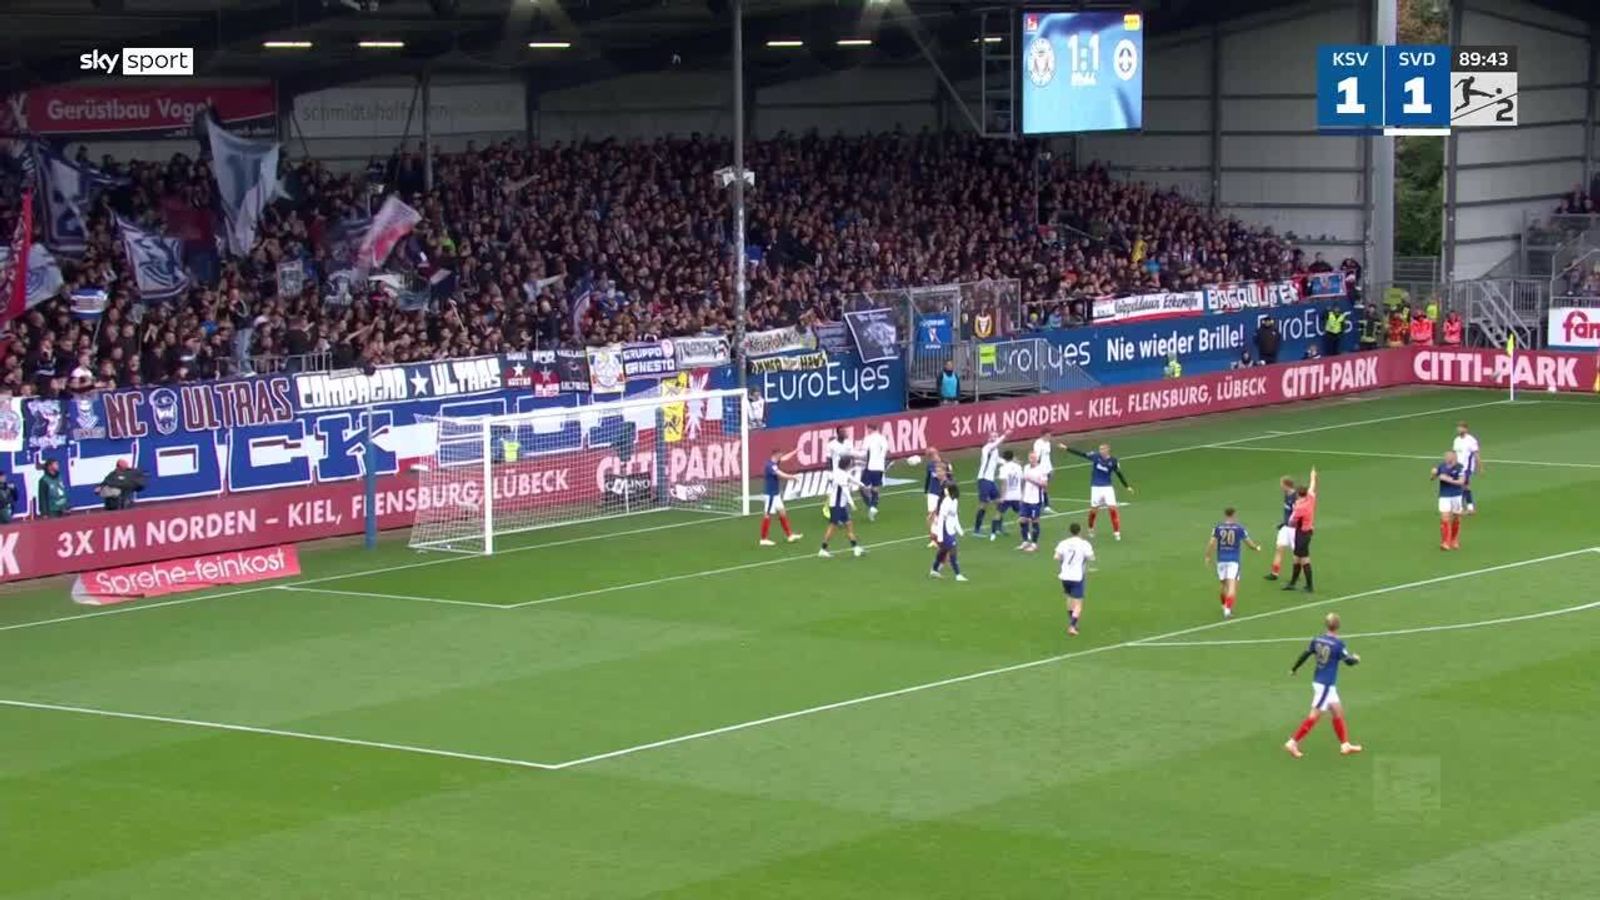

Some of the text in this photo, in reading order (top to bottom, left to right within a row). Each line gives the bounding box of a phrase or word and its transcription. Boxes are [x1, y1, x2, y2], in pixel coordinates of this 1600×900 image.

[1067, 34, 1099, 72] 1:1
[47, 98, 150, 121] Gerüstbau
[623, 347, 663, 359] GRUPPO
[1107, 324, 1243, 362] Nie wieder Brille!
[430, 357, 501, 395] ULTRAS
[764, 362, 891, 402] EuroEyes
[1281, 356, 1379, 398] CITTI-PARK
[1413, 350, 1579, 388] CITTI-PARK
[104, 379, 293, 439] NC ULTRAS
[950, 415, 972, 437] 3X
[977, 412, 997, 433] IM
[1002, 403, 1070, 430] NORDEN
[1088, 397, 1123, 419] KIEL,
[1127, 385, 1212, 413] FLENSBURG,
[1217, 376, 1267, 401] LÜBECK
[796, 416, 929, 466] CITI-ARK
[57, 530, 95, 558] 3X
[103, 523, 136, 552] IM
[146, 509, 256, 543] NORDEN
[288, 502, 343, 528] KIEL,
[492, 468, 569, 500] LÜBECK
[1219, 529, 1236, 546] 20
[96, 548, 286, 595] Sprehe-feinkost
[1067, 549, 1077, 566] 7
